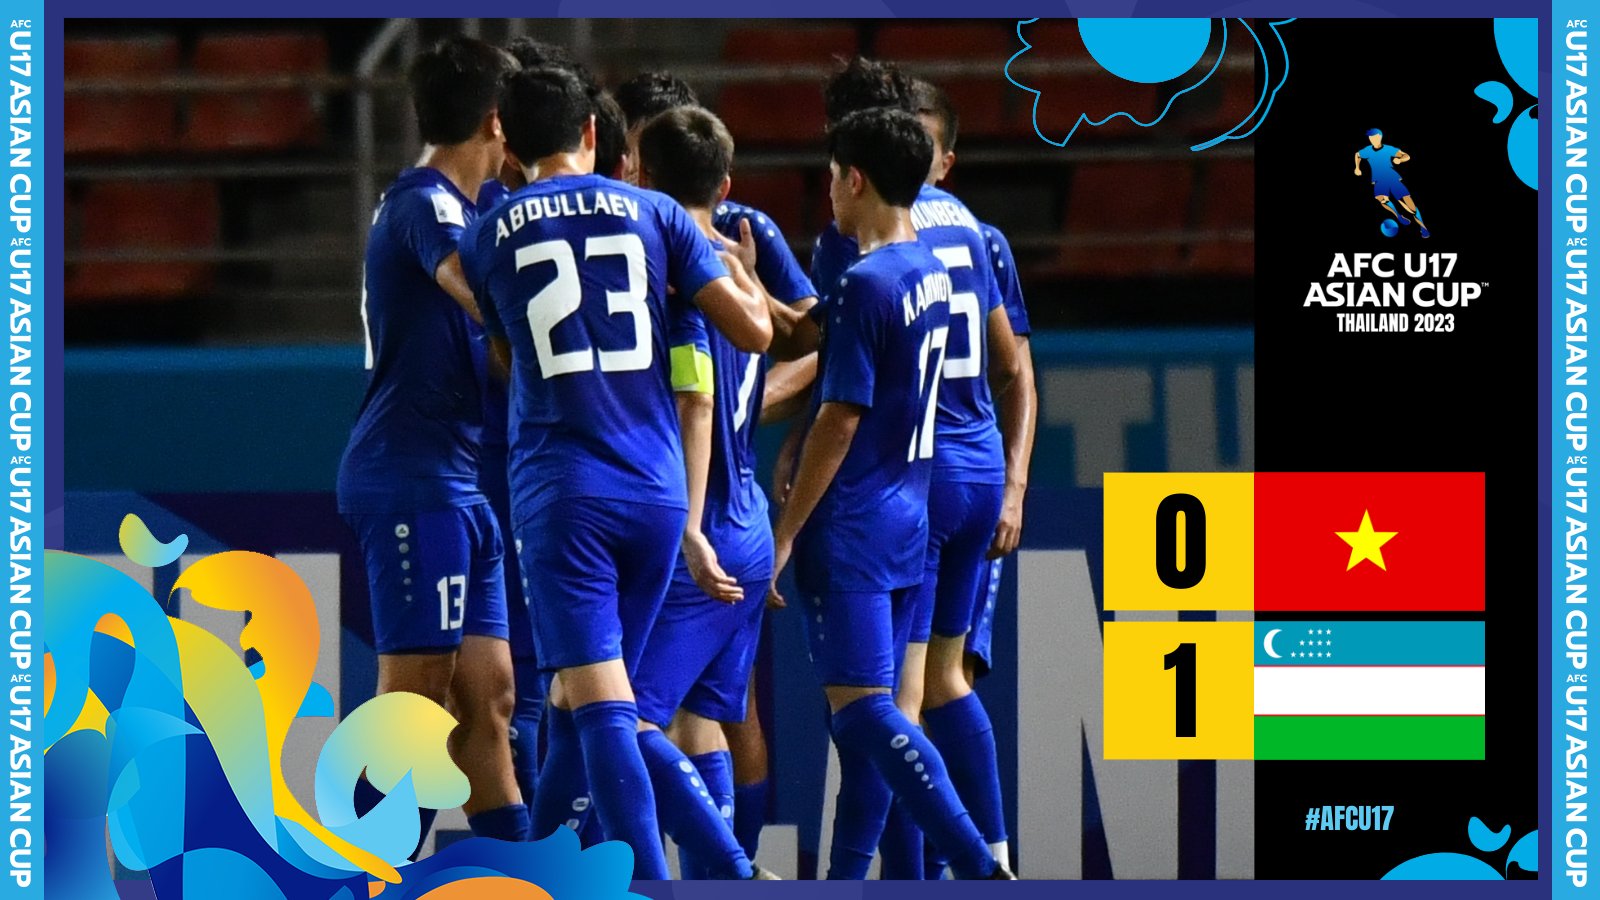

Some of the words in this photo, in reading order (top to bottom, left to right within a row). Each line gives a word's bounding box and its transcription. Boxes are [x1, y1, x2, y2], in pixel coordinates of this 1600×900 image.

[495, 191, 639, 247] ABDULLAEV
[515, 233, 653, 379] 23
[907, 325, 950, 463] 17
[436, 574, 466, 631] 13
